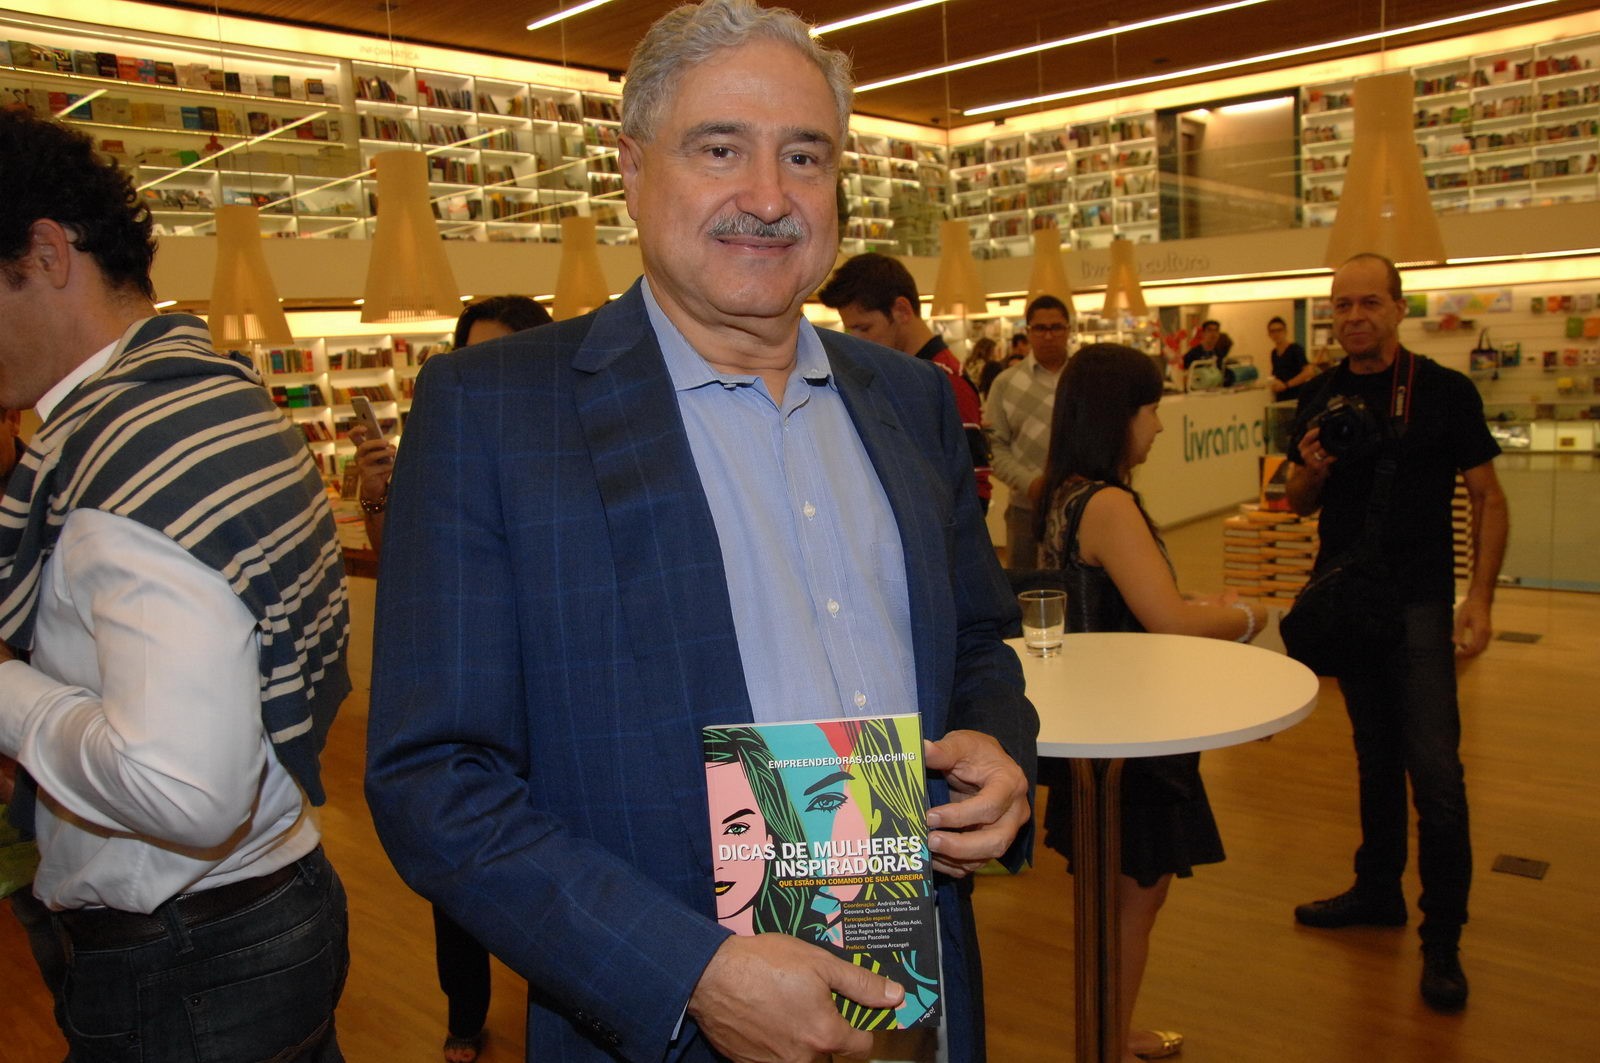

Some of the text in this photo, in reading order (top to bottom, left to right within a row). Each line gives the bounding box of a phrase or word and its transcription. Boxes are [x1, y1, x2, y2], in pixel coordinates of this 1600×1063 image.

[1184, 414, 1249, 463] livraria
[718, 835, 923, 861] DICAS DE MULHERES
[775, 853, 924, 878] INSPIRADORAS
[779, 880, 793, 888] QUE
[794, 878, 815, 887] ESTÃO
[816, 878, 827, 886] NO
[828, 876, 863, 885] COMANDO
[890, 873, 924, 881] CARREIRA
